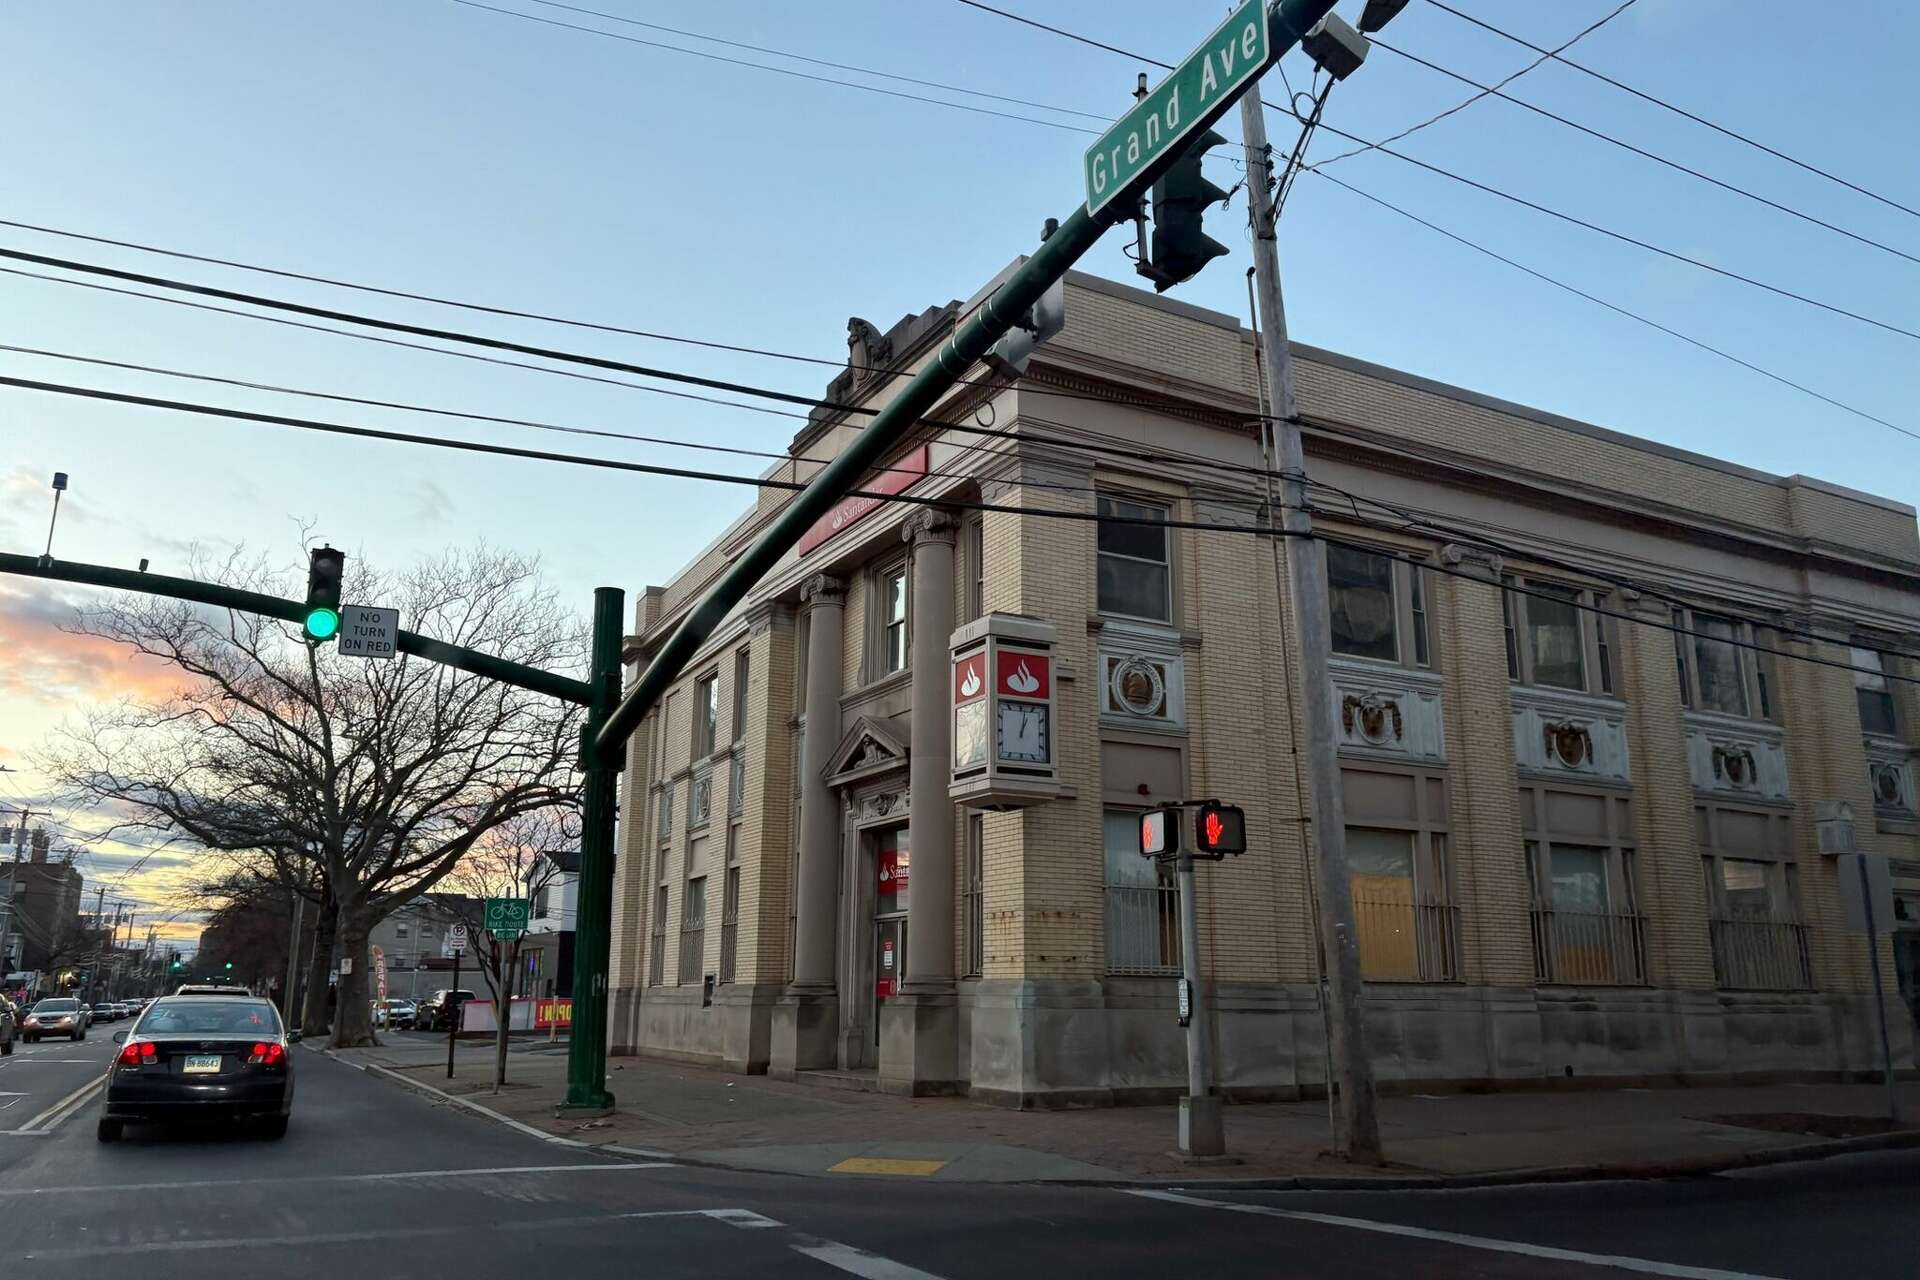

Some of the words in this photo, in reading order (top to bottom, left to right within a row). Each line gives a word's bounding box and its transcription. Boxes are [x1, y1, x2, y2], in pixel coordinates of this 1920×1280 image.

[1092, 84, 1180, 194] Grand
[1200, 21, 1258, 101] Ave
[360, 612, 381, 624] NO
[353, 625, 386, 638] TURN
[344, 639, 362, 649] ON
[367, 640, 391, 652] RED
